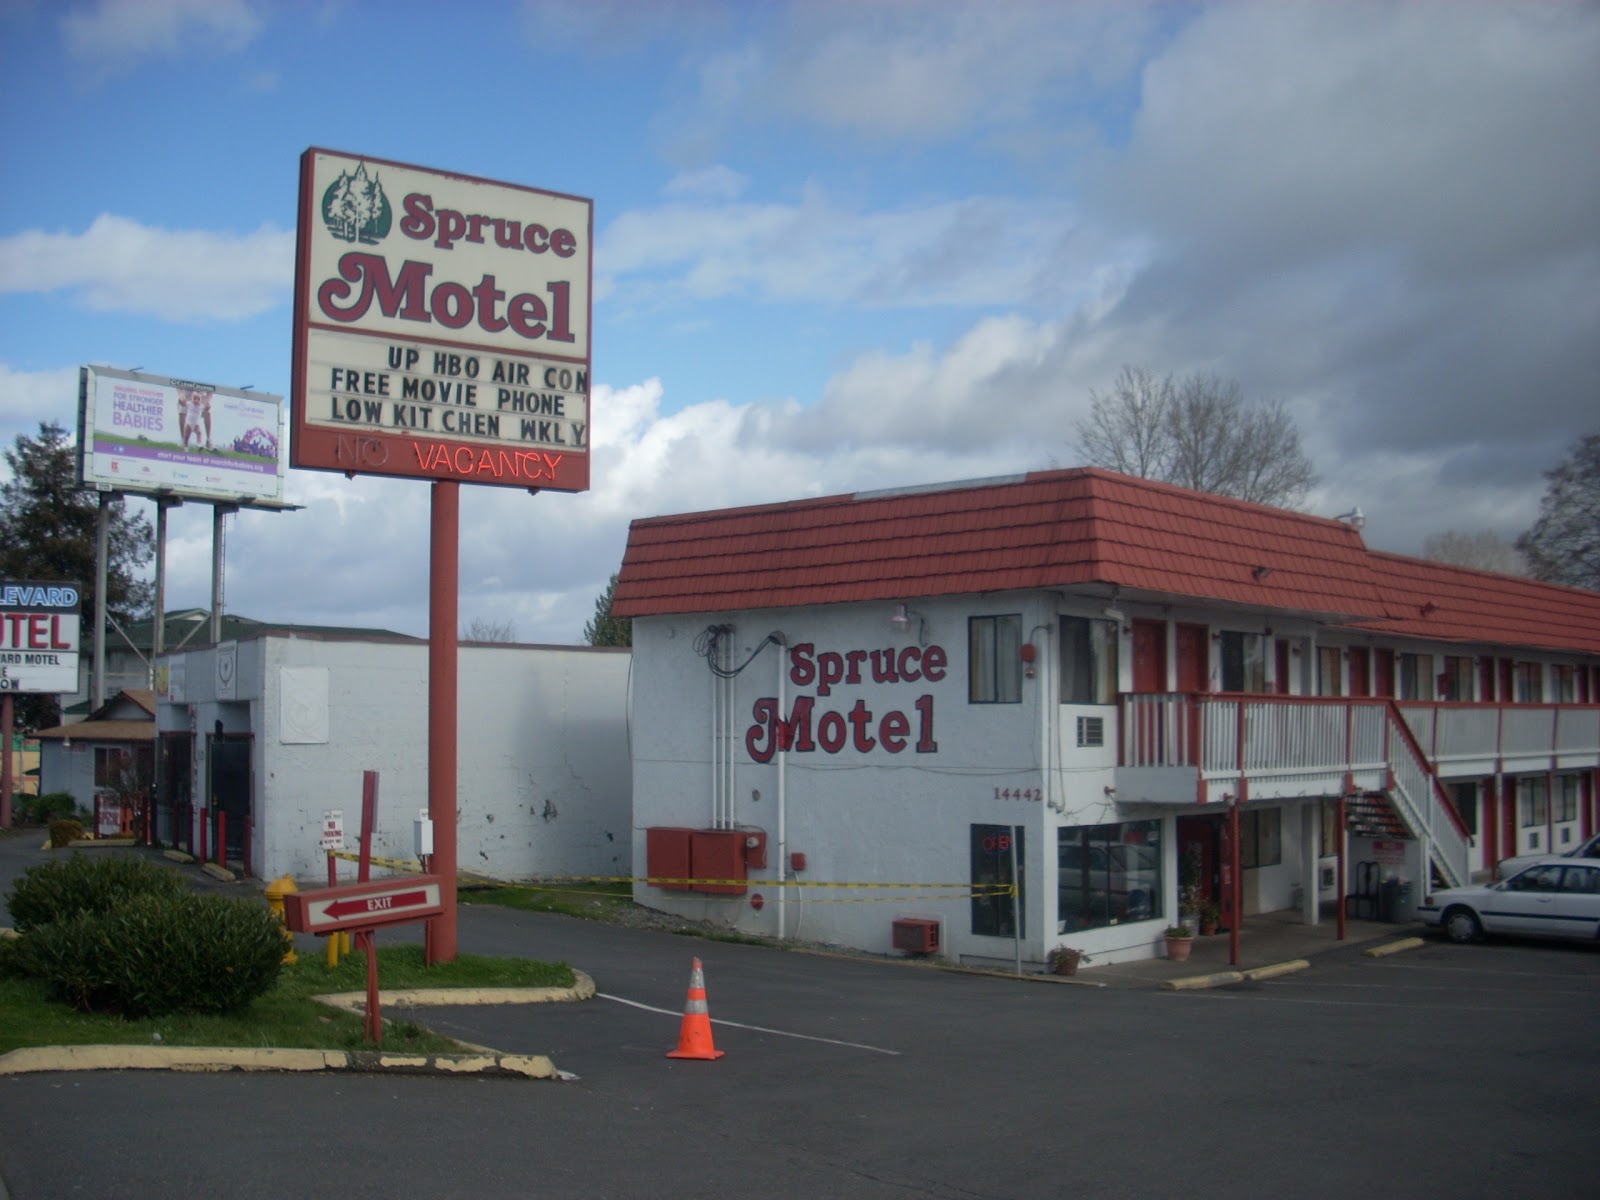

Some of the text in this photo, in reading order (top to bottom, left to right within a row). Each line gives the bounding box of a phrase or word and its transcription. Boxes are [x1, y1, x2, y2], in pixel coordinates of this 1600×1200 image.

[400, 193, 577, 258] Spruce
[318, 251, 575, 343] Motel
[332, 368, 565, 417] FREE MOVIE PHONE
[388, 346, 587, 393] UP HBO AIR CON
[113, 401, 163, 416] HEALTHIER
[113, 411, 163, 432] BABIES
[332, 397, 382, 424] LOW
[520, 418, 586, 446] WKLY
[337, 434, 562, 480] NO VACANCY
[0, 613, 71, 650] TEL
[25, 654, 60, 665] MOTEL
[789, 642, 948, 696] Spruce
[746, 694, 938, 763] Motel
[993, 787, 1042, 801] 14442
[367, 897, 392, 911] EXIT
